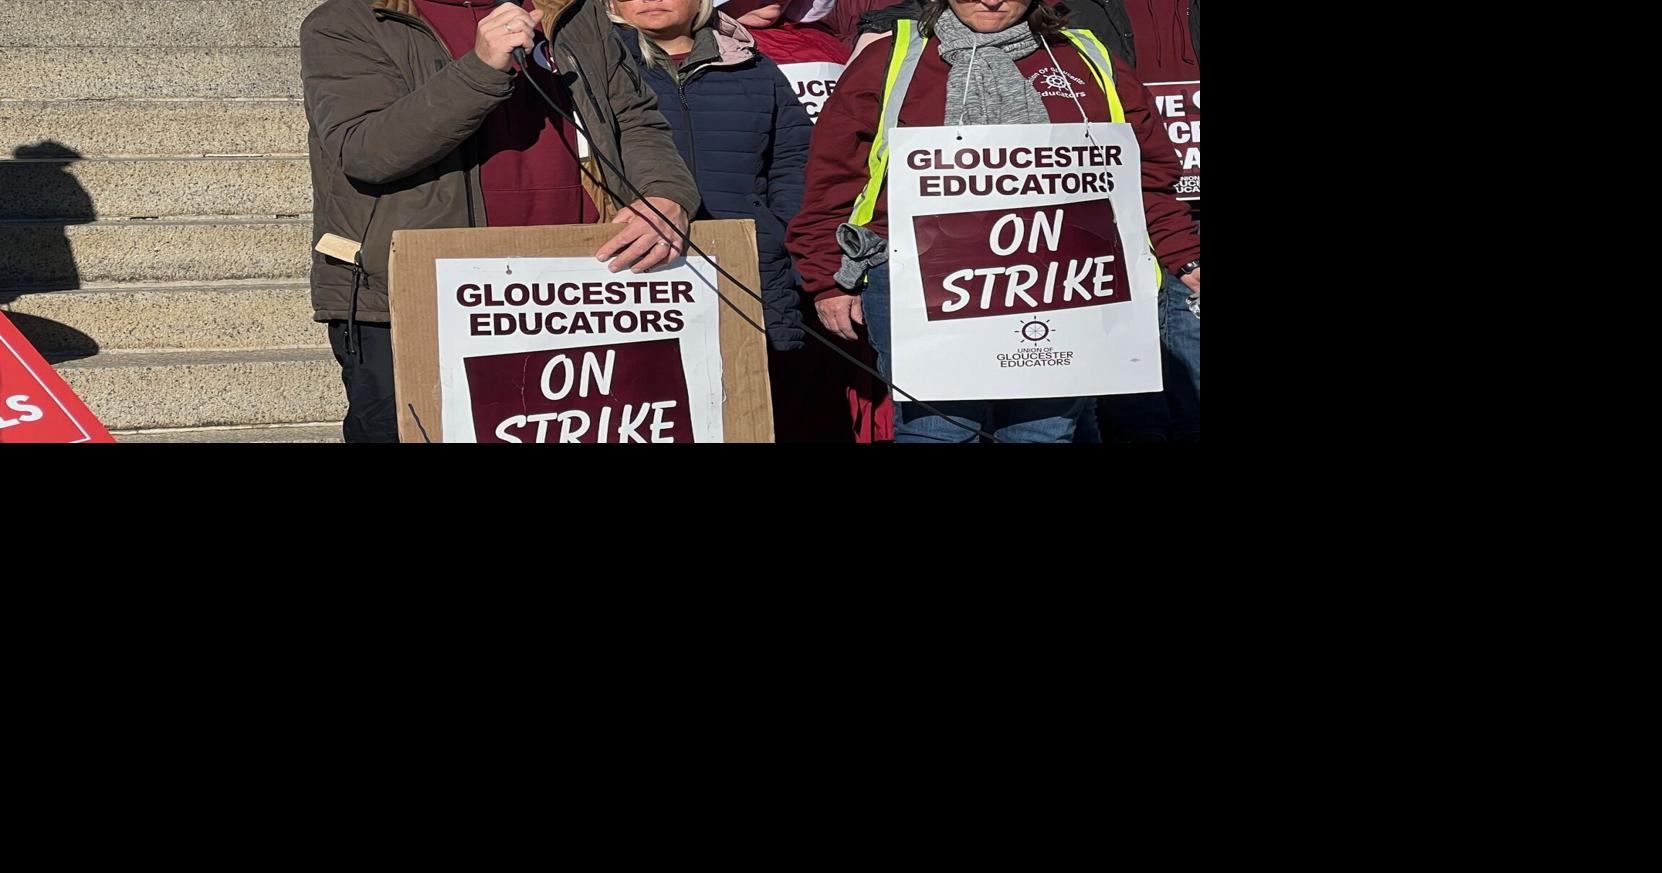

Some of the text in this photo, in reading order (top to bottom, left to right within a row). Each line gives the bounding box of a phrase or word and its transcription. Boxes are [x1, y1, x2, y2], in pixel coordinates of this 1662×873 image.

[906, 145, 1123, 171] GLOUCESTER
[919, 171, 1115, 197] EDUCATORS
[989, 209, 1064, 256] ON
[456, 281, 695, 307] GLOUCESTER
[941, 255, 1115, 312] STRIKE
[469, 309, 684, 336] EDUCATORS
[996, 351, 1074, 361] GLOUCESTER
[1000, 359, 1071, 368] EDUCATORS
[540, 349, 616, 400] ON
